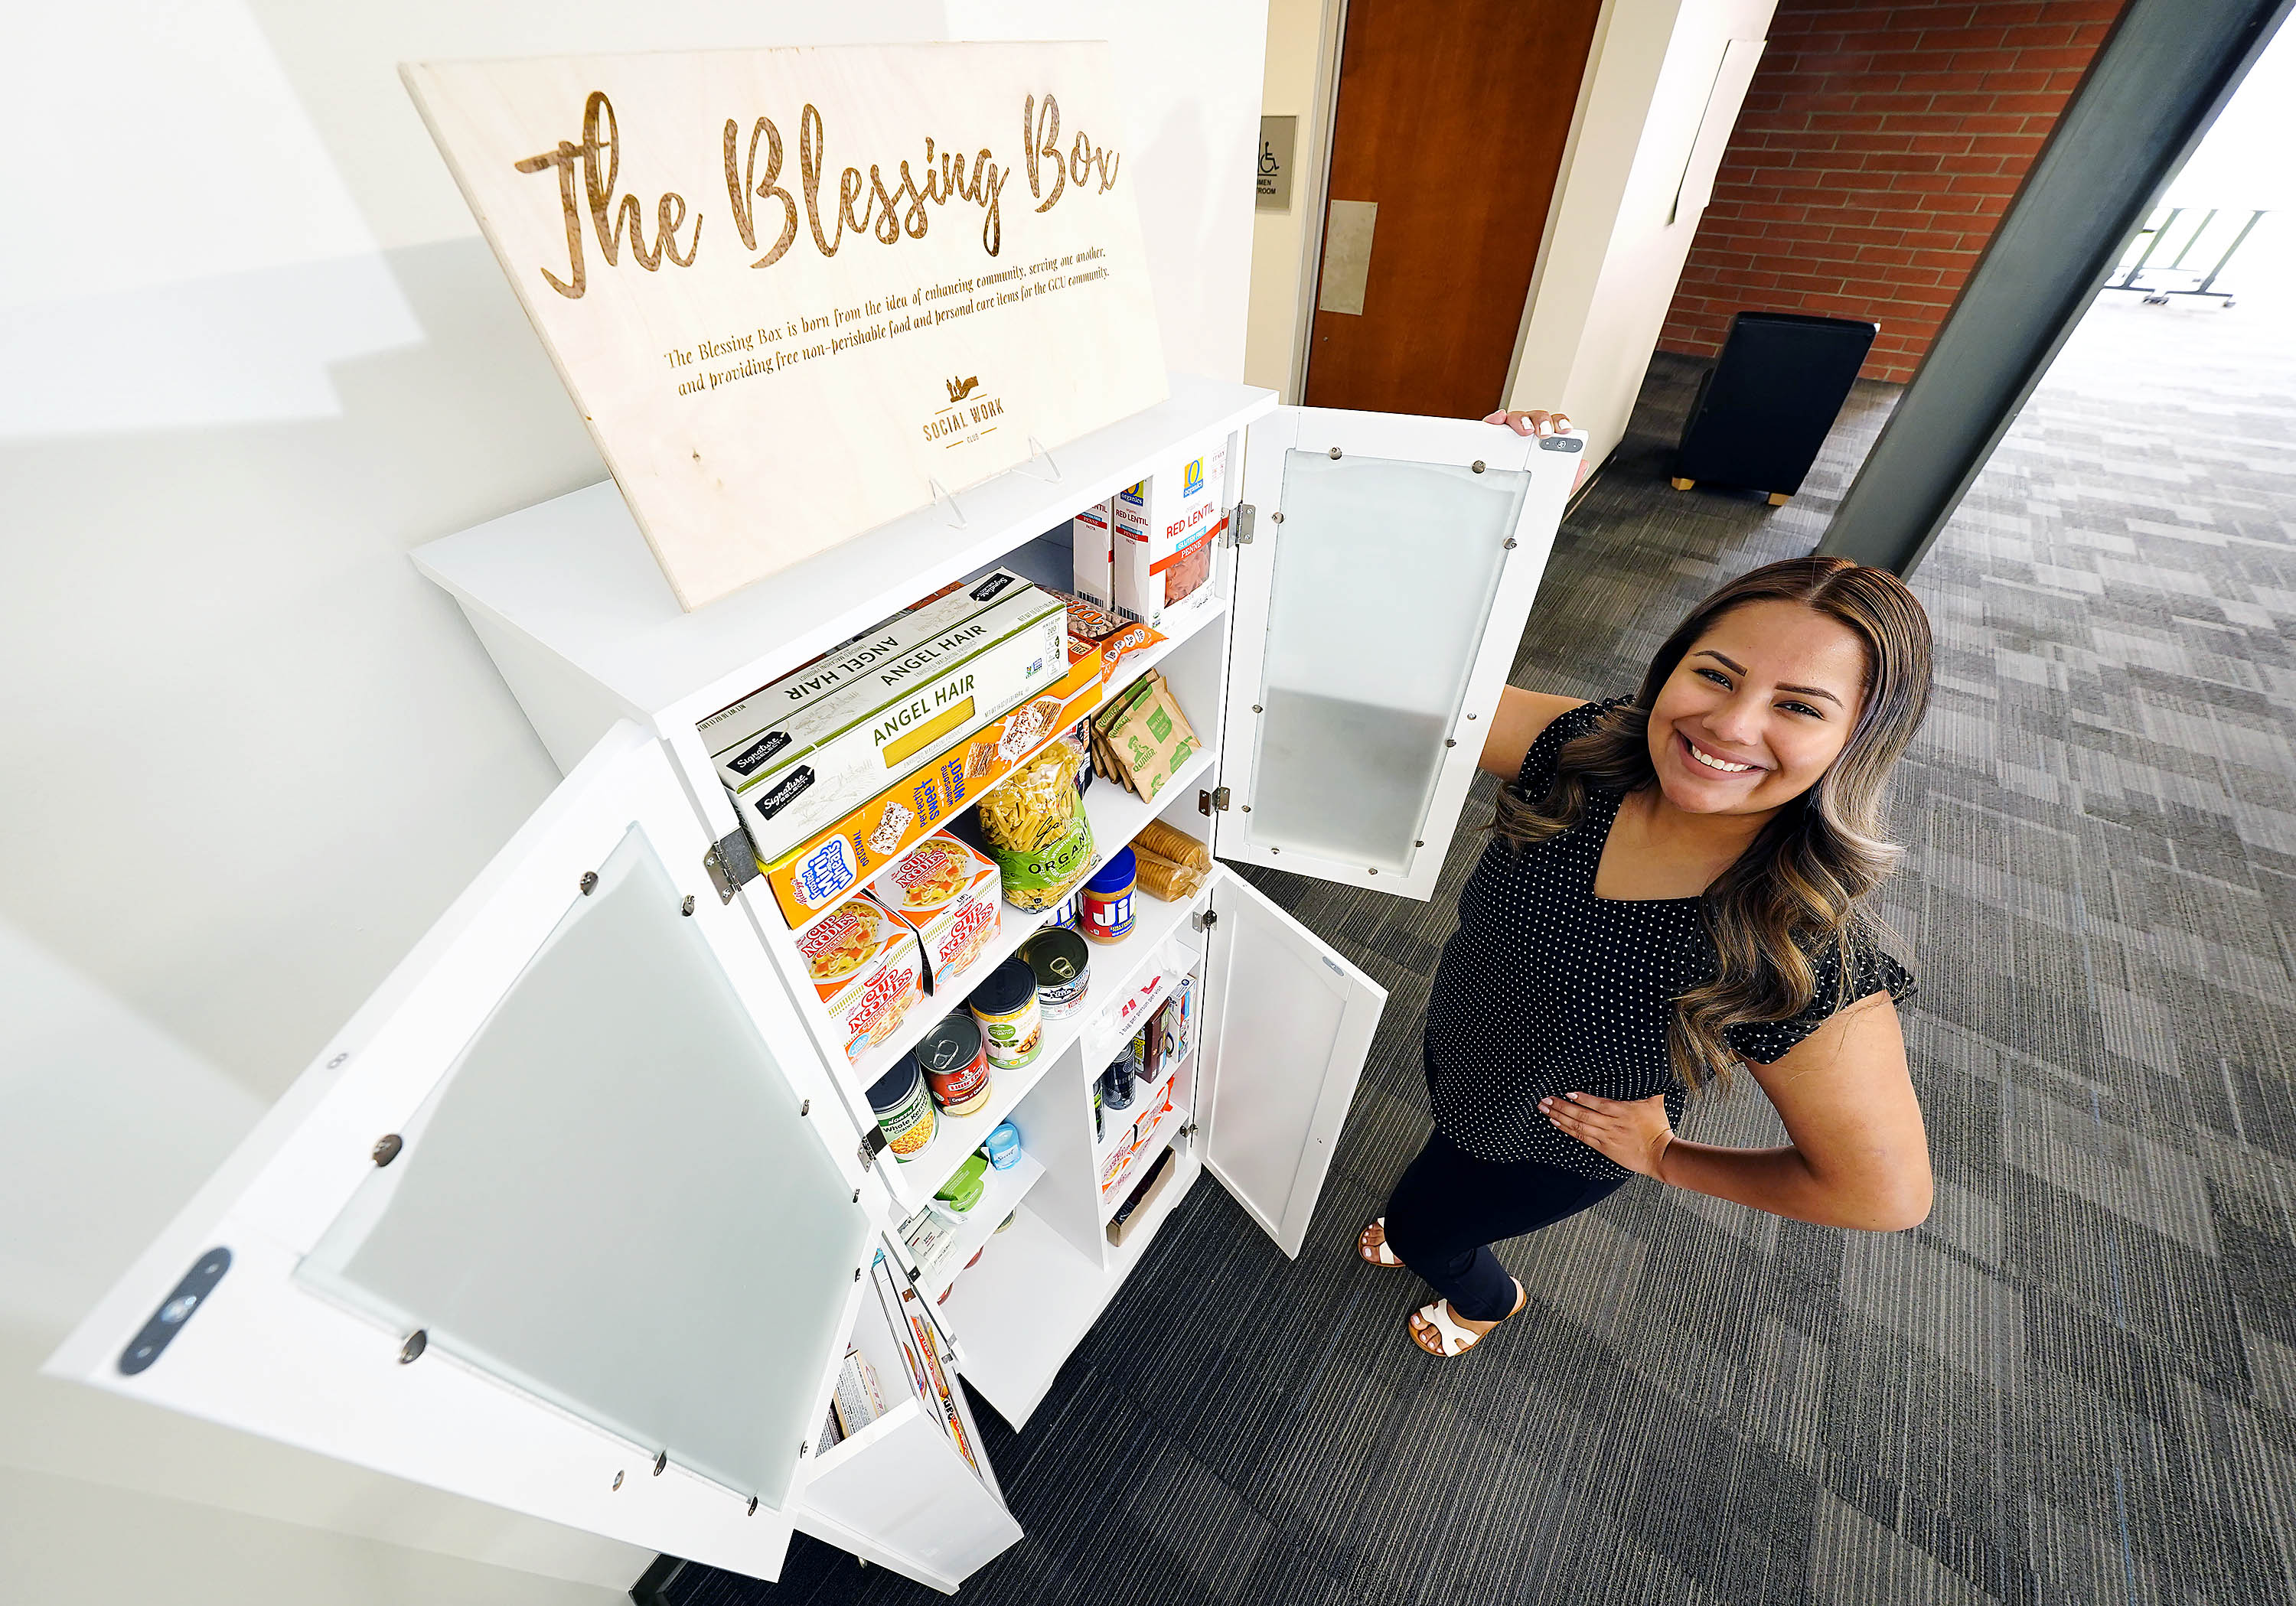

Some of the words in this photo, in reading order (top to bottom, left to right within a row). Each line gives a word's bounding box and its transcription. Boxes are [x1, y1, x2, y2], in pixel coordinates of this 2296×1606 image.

[514, 90, 703, 299] The
[724, 103, 1009, 269] Blessing
[1024, 93, 1120, 213] Box
[664, 349, 693, 369] The
[698, 334, 754, 361] Blessing
[758, 327, 783, 345] Box
[787, 321, 797, 337] is
[801, 315, 830, 334] born
[833, 305, 861, 327] from
[866, 300, 882, 317] the
[885, 295, 908, 311] idea
[912, 288, 921, 306] of
[925, 279, 974, 301] enhancing
[977, 265, 1027, 288] community,
[1029, 257, 1058, 275] serving
[1060, 254, 1073, 268] one
[1076, 246, 1106, 264] another.
[678, 373, 705, 396] and
[709, 357, 775, 390] providing
[775, 350, 800, 371] free
[802, 324, 887, 361] non-perishable
[889, 317, 911, 339] food
[914, 311, 932, 329] and
[934, 298, 974, 325] personal
[976, 296, 995, 312] care
[996, 288, 1019, 306] items
[1020, 285, 1033, 302] for
[1034, 282, 1046, 296] the
[1048, 275, 1066, 292] GCU
[1068, 265, 1110, 287] community.
[923, 412, 968, 441] SOCIAL
[970, 398, 1004, 423] WORK
[967, 433, 979, 444] CLUB
[1092, 503, 1107, 513] NTIL
[1121, 494, 1142, 504] organics
[1116, 509, 1127, 518] RED
[1128, 513, 1149, 526] LENTIL
[1167, 520, 1185, 539] RED
[1189, 502, 1214, 527] LENTIL
[1181, 540, 1202, 558] PENNE
[838, 636, 899, 673] ANGEL
[880, 650, 941, 686] ANGEL
[937, 625, 987, 650] HAIR
[784, 671, 840, 700] HAIR
[873, 699, 931, 747] ANGEL
[935, 674, 975, 707] HAIR
[737, 737, 779, 768] Signature
[755, 738, 783, 761] SELECT
[764, 774, 807, 810] Signature
[779, 777, 808, 803] SELECT
[941, 765, 954, 807] wholesome
[853, 829, 869, 867] ORIGINAL
[900, 852, 927, 873] CUP
[1028, 816, 1088, 875] ORGANIC
[809, 852, 838, 897] Mini
[822, 840, 853, 889] Wheats
[896, 851, 946, 888] NOODLES
[913, 868, 937, 887] CHICKEN
[791, 878, 807, 904] Kellogg's
[802, 869, 821, 900] Frosted
[801, 914, 857, 958] NOODLES
[807, 915, 837, 939] CUP
[940, 903, 993, 962] NOODLES
[951, 903, 982, 937] CUP
[820, 933, 844, 955] CHICKEN
[849, 969, 912, 1034] NOODLES
[862, 969, 898, 1008] CUP
[1122, 1023, 1132, 1032] bag
[1136, 1002, 1149, 1017] person
[1154, 986, 1163, 995] visit
[883, 1119, 910, 1133] Whole
[894, 1123, 912, 1135] Grano
